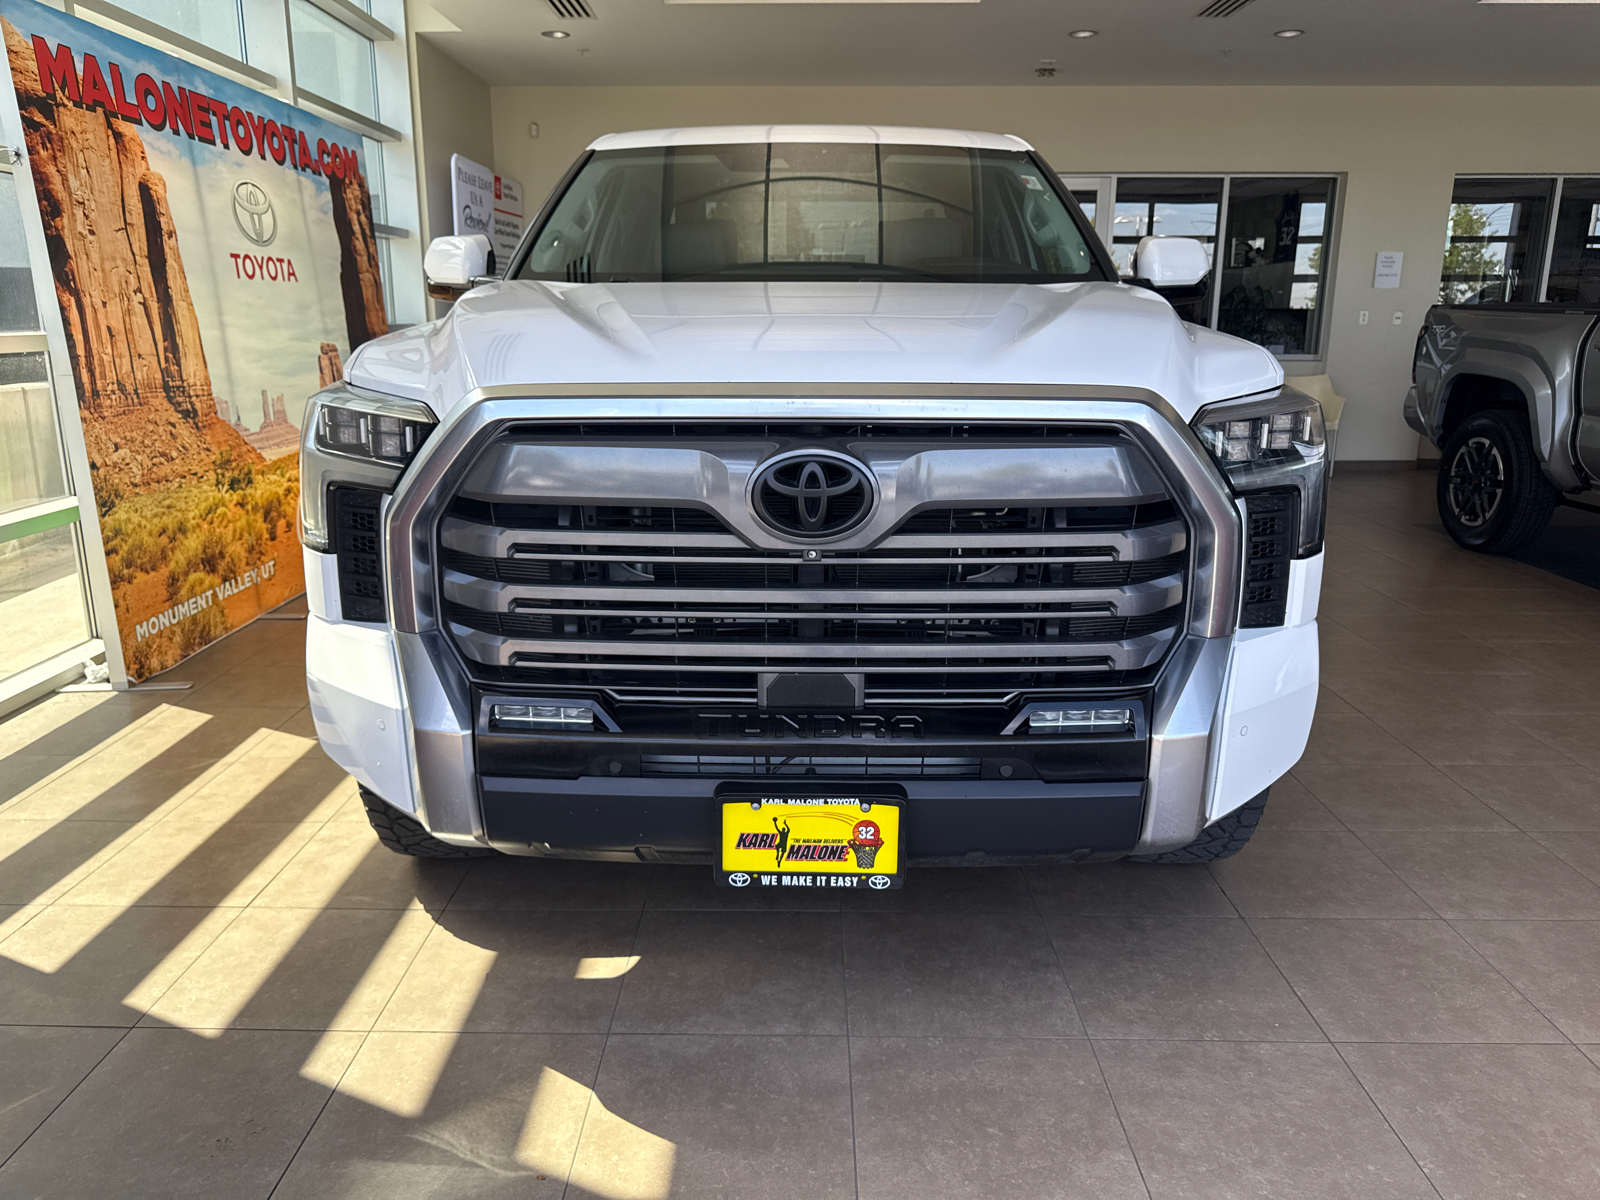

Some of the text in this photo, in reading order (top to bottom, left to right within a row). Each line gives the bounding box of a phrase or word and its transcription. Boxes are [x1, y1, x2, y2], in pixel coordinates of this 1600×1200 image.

[31, 33, 361, 187] MALONETOYOTA.COM
[457, 166, 493, 194] PLEASE LEAVE
[1279, 226, 1295, 246] 32
[230, 252, 299, 283] TOYOTA
[135, 560, 276, 642] MONUMENT VALLEY, UT
[698, 714, 924, 738] TUNDRA
[788, 798, 825, 806] MALONE
[826, 798, 861, 806] TOYOTA
[735, 832, 779, 850] KARL
[858, 826, 875, 840] 32
[785, 844, 850, 861] MALONE
[761, 875, 858, 887] WE MAKE IT EASY
